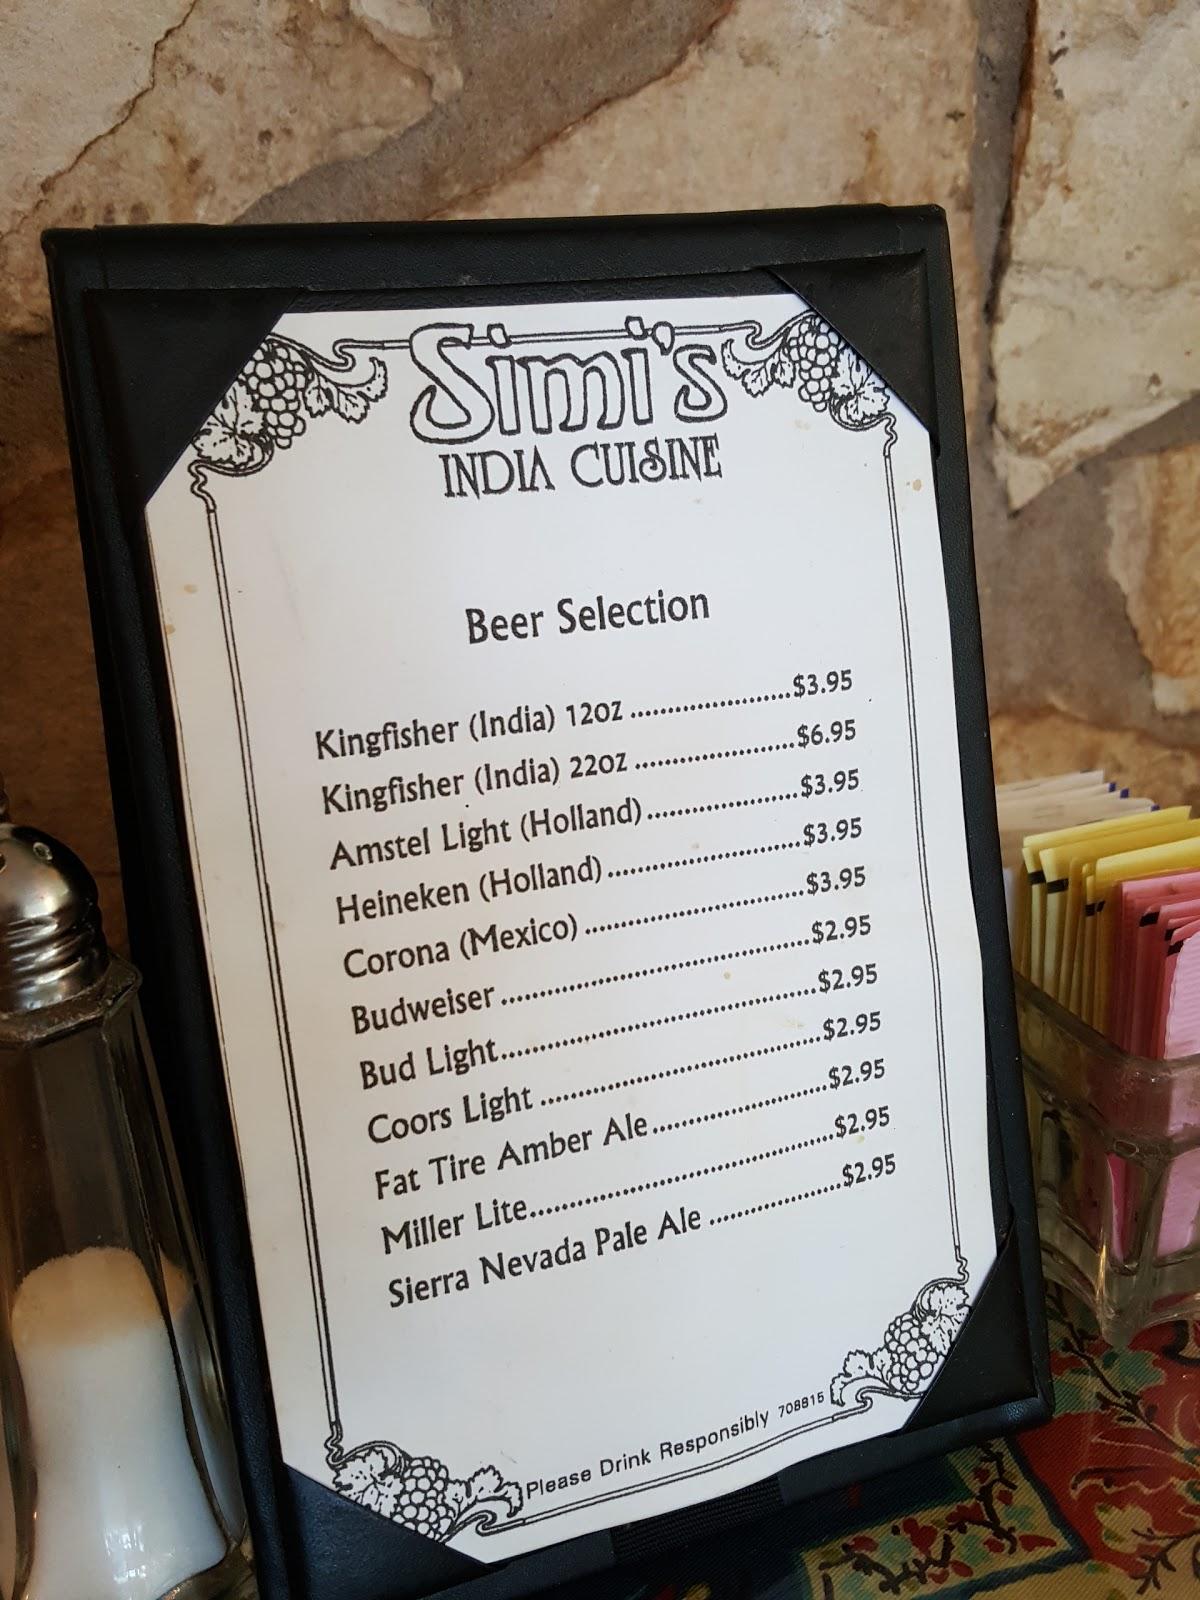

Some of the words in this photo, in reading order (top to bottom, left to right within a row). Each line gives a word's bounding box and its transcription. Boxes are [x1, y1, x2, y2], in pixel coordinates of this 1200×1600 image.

[409, 316, 728, 445] Simi's
[438, 445, 555, 500] INDIA
[571, 432, 722, 488] CUISINE
[465, 608, 544, 644] Beer
[557, 589, 709, 634] Selection
[315, 719, 459, 760] Kingfisher
[469, 704, 555, 742] (India)
[793, 669, 852, 698] $3.95
[322, 773, 464, 815] Kingfisher
[475, 757, 559, 795] (India)
[797, 719, 856, 749] $6.95
[330, 827, 430, 870] Amstel
[441, 818, 511, 852] Light
[521, 797, 641, 842] (Holland)
[801, 768, 859, 799] $3.95
[336, 882, 470, 924] Heineken
[480, 855, 601, 902] (Holland)
[803, 817, 862, 847] $3.95
[344, 942, 450, 978] Corona
[460, 913, 577, 960] (Mexico)
[807, 866, 865, 896] $3.95
[351, 987, 494, 1035] Budweiser
[812, 914, 871, 944] $2.95
[360, 1051, 416, 1090] Bud
[426, 1039, 499, 1076] Light
[818, 963, 877, 994] $2.95
[368, 1107, 452, 1143] Coors
[463, 1086, 533, 1123] Light
[823, 1011, 880, 1041] $2.95
[375, 1168, 420, 1200] Fat
[428, 1154, 485, 1185] Tire
[497, 1130, 592, 1170] Amber
[603, 1113, 647, 1146] Ale
[829, 1058, 885, 1090] $2.95
[381, 1214, 464, 1255] Miller
[475, 1199, 527, 1230] Lite
[835, 1105, 889, 1139] $2.95
[389, 1270, 469, 1308] Sierra
[479, 1236, 586, 1284] Nevada
[595, 1221, 647, 1256] Pale
[658, 1207, 701, 1240] Ale
[842, 1153, 895, 1188] $2.95
[527, 1469, 591, 1499] Please
[600, 1448, 651, 1477] Drink
[660, 1410, 768, 1460] Responsibly
[778, 1391, 824, 1418] 708815
